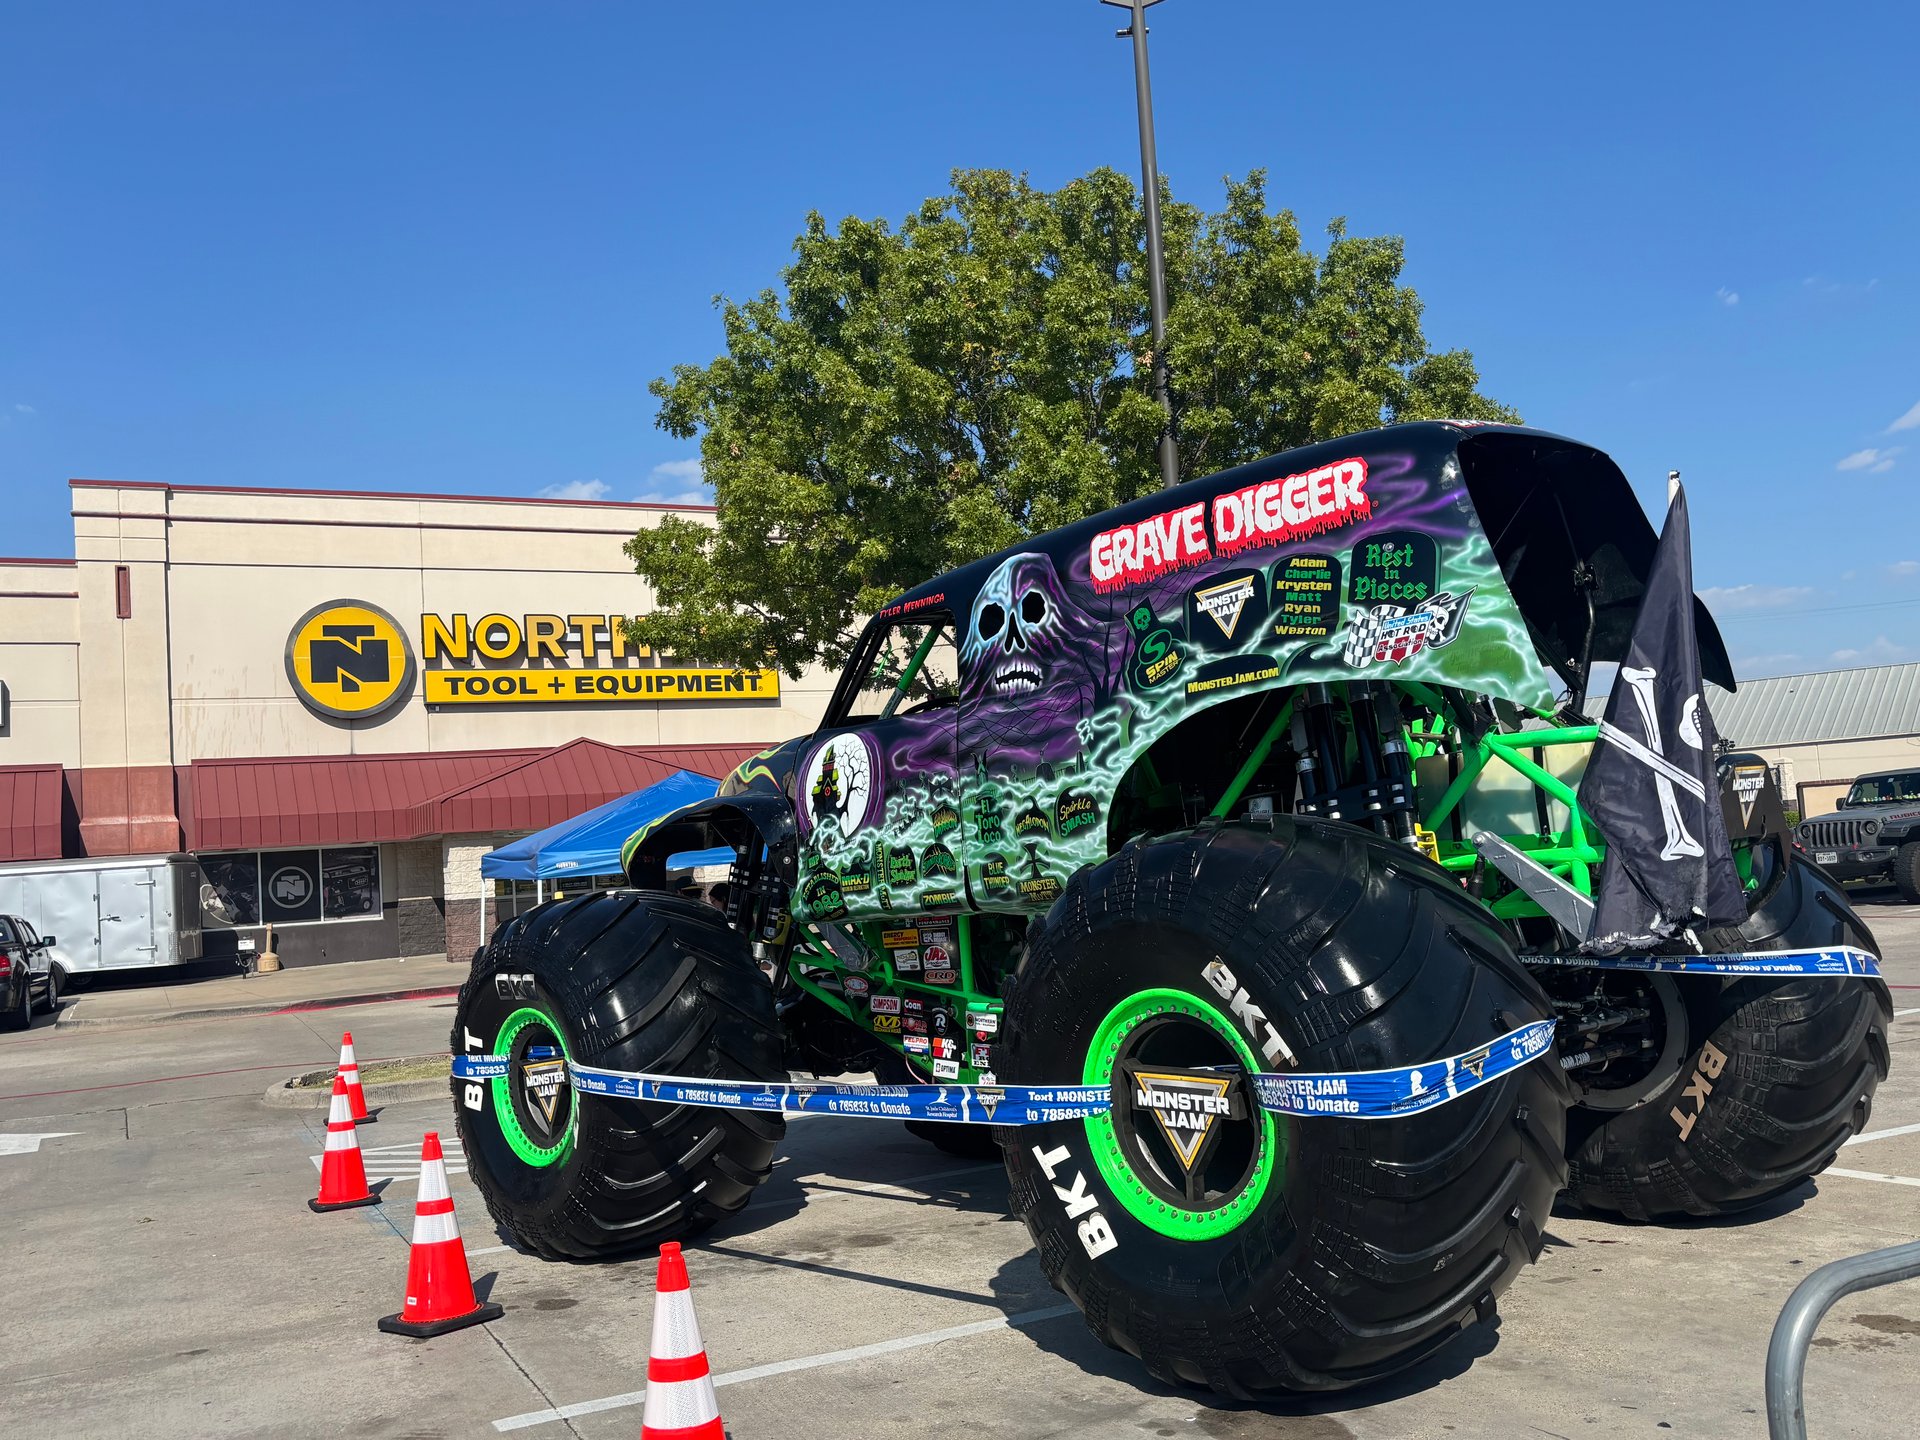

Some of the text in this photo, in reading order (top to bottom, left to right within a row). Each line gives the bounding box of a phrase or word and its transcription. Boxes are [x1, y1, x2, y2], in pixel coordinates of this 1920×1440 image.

[1090, 459, 1369, 588] GRAVE DIGGER
[1290, 558, 1327, 568] Adam
[1365, 543, 1413, 568] Rest
[1285, 569, 1331, 580] Charlie
[1384, 567, 1400, 579] in
[1276, 580, 1332, 592] Krysten
[1355, 576, 1428, 600] Pieces
[1196, 586, 1255, 613] MONSTER
[1285, 592, 1322, 602] Matt
[880, 593, 945, 619] TYLER MENNINGA
[1214, 600, 1241, 618] JAM
[1284, 603, 1321, 615] Ryan
[1281, 614, 1322, 626] Tyler
[1275, 625, 1327, 635] Weston
[1381, 623, 1427, 640] HOT ROD
[1378, 638, 1426, 652] Association
[1145, 651, 1178, 678] SPIN
[1148, 658, 1180, 685] MASTER
[444, 676, 538, 696] TOOL
[575, 675, 763, 697] EQUIPMENT
[1732, 777, 1765, 791] MONSTER
[1740, 789, 1757, 803] JAM
[1060, 798, 1092, 820] Sparkle
[1061, 812, 1096, 838] SMASH
[987, 861, 1004, 876] BLUE
[841, 873, 870, 887] MAX-D
[1020, 878, 1058, 893] MONSTER
[807, 891, 844, 916] 1982
[922, 893, 957, 905] ZOMBIE
[925, 947, 948, 961] JAZ
[872, 998, 898, 1010] SIMPSON
[904, 1000, 922, 1010] Coan
[1201, 955, 1299, 1067] BKT
[1511, 1046, 1524, 1060] to
[464, 1026, 485, 1111] BT
[466, 1067, 474, 1075] to
[941, 1065, 956, 1073] OPTIMA
[526, 1071, 566, 1088] MONSTER
[588, 1079, 607, 1091] Donate
[538, 1085, 557, 1097] JAM
[852, 1086, 909, 1098] MONSTERJAM
[1264, 1079, 1348, 1096] MONSTERJAM
[1670, 1040, 1728, 1142] BKT
[677, 1088, 684, 1100] to
[685, 1089, 709, 1102] 785833
[709, 1091, 717, 1102] to
[717, 1092, 741, 1104] Donate
[1136, 1089, 1231, 1116] MONSTER
[829, 1099, 911, 1115] to 785833 to Donate
[1292, 1096, 1304, 1110] to
[1307, 1095, 1360, 1113] Donate
[1027, 1108, 1038, 1121] to
[1164, 1110, 1206, 1131] JAM
[1031, 1144, 1119, 1260] BKT
